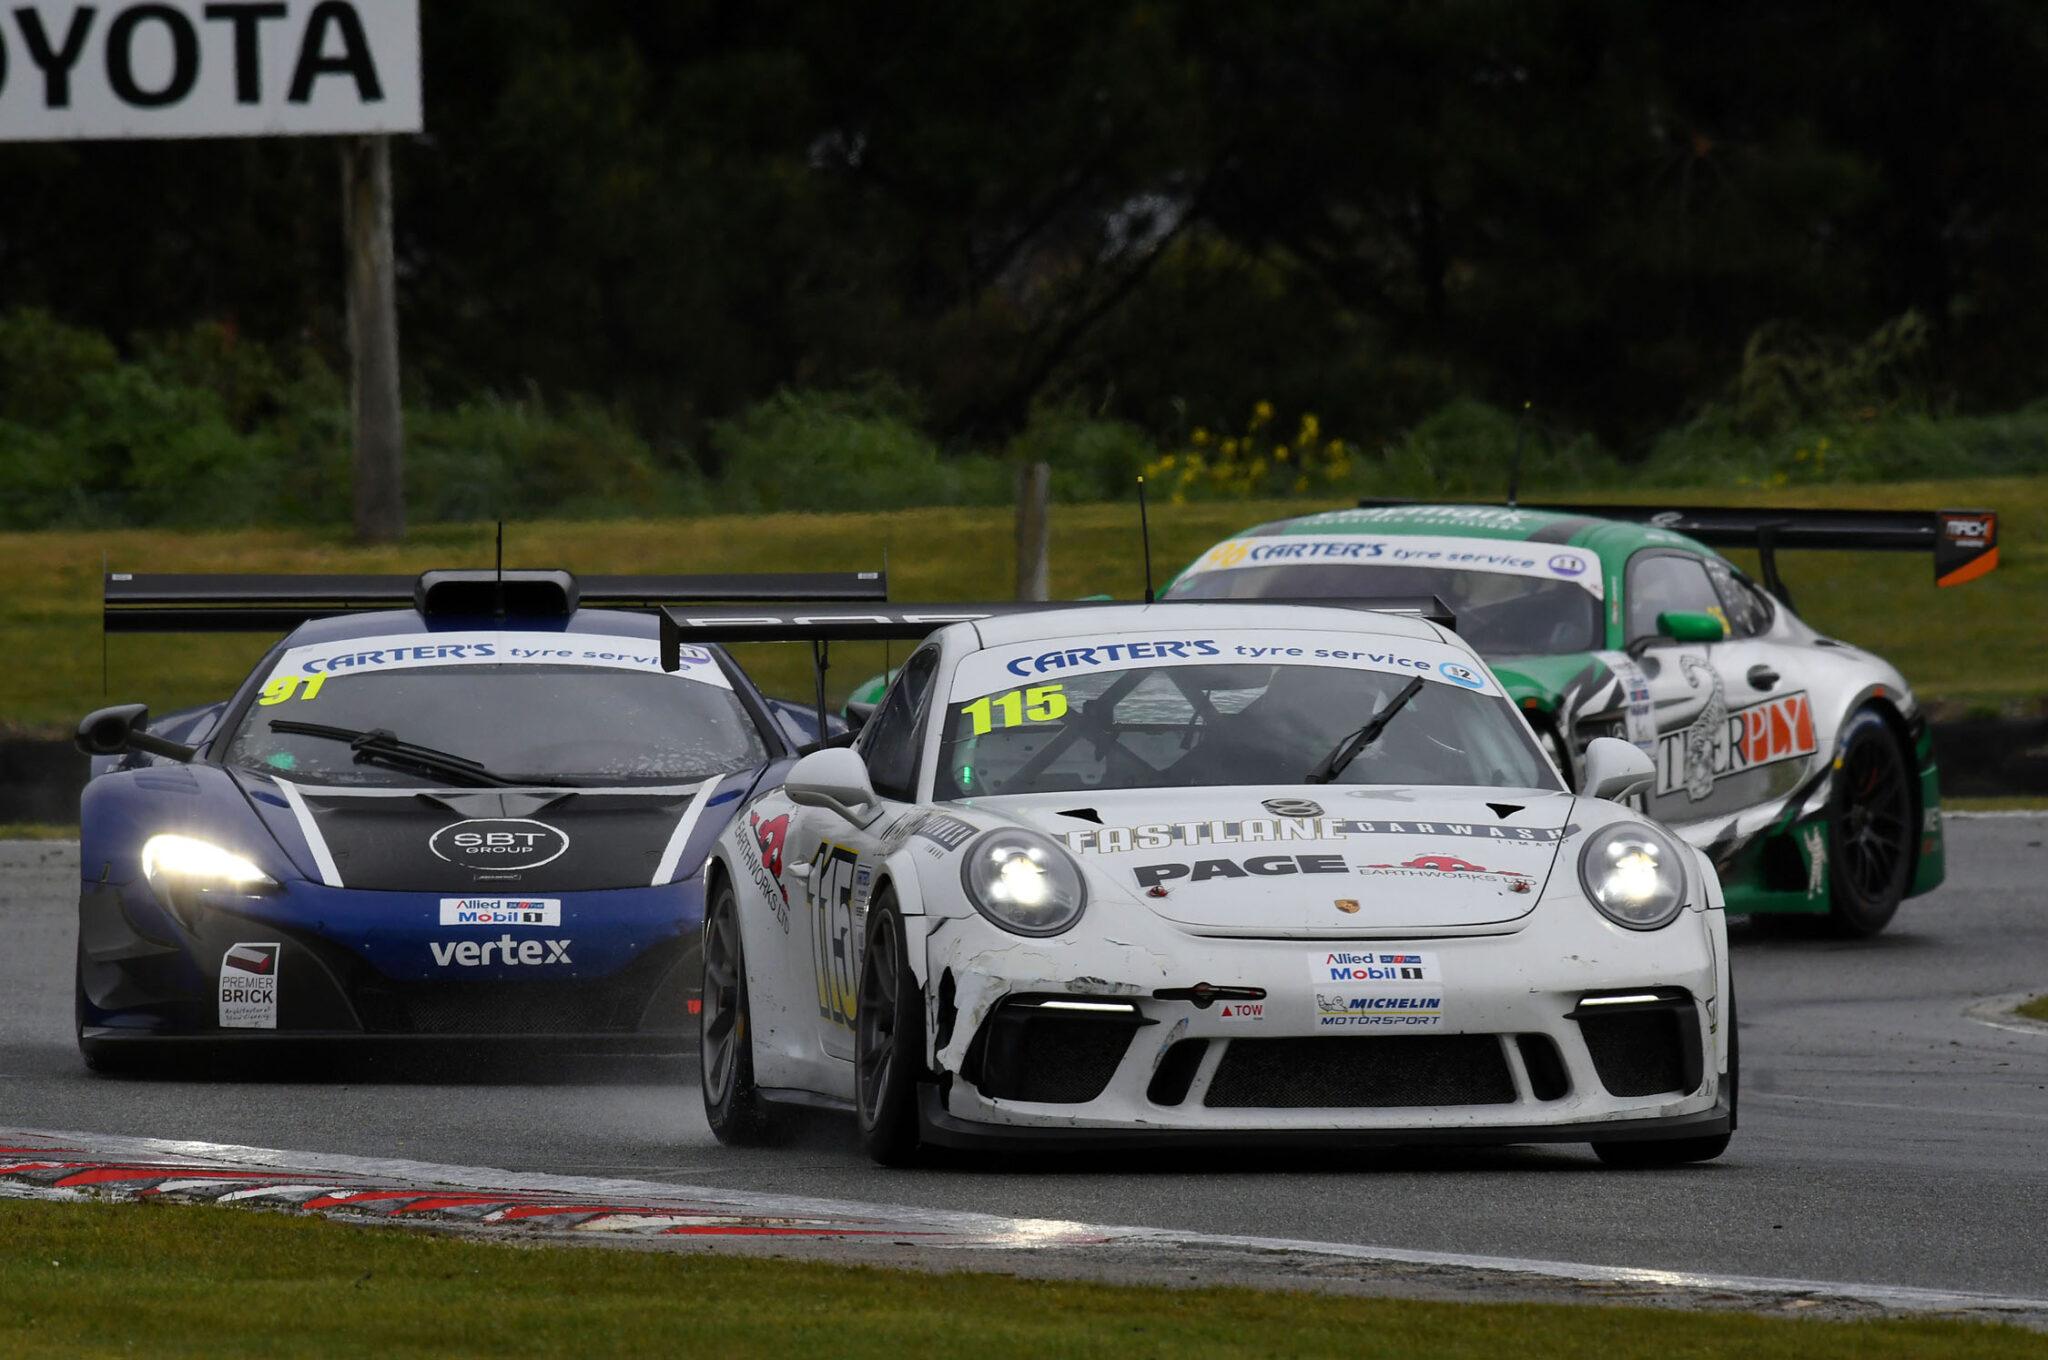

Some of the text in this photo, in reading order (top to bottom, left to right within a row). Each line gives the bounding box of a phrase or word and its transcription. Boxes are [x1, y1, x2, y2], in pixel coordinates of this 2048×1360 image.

[0, 0, 385, 110] YOTA
[1251, 543, 1535, 568] CARTER'S tyre service
[302, 643, 691, 674] CARTER'S tyre servie
[1007, 639, 1431, 677] CARTER'S tyre service
[259, 671, 327, 706] 91
[961, 684, 1068, 736] 115
[1659, 694, 1815, 790] TIERPLY
[454, 833, 546, 847] SBT
[1066, 817, 1568, 854] FASTLANE CARWASH
[735, 820, 777, 911] EARTHWORKS
[1133, 855, 1350, 887] PAGE
[1359, 868, 1538, 886] EARTHWORKS LTD
[457, 900, 500, 909] Allied
[459, 912, 518, 922] Mobil
[807, 838, 858, 1030] 115
[430, 934, 572, 966] vertex
[1327, 953, 1374, 964] Allied
[222, 977, 273, 989] PREMIER
[1331, 967, 1396, 980] Mobil
[222, 989, 273, 1004] BRICK
[1349, 998, 1440, 1009] MICHELIN
[1234, 1004, 1263, 1016] TOW
[1321, 1016, 1440, 1025] MOTORSPORT
